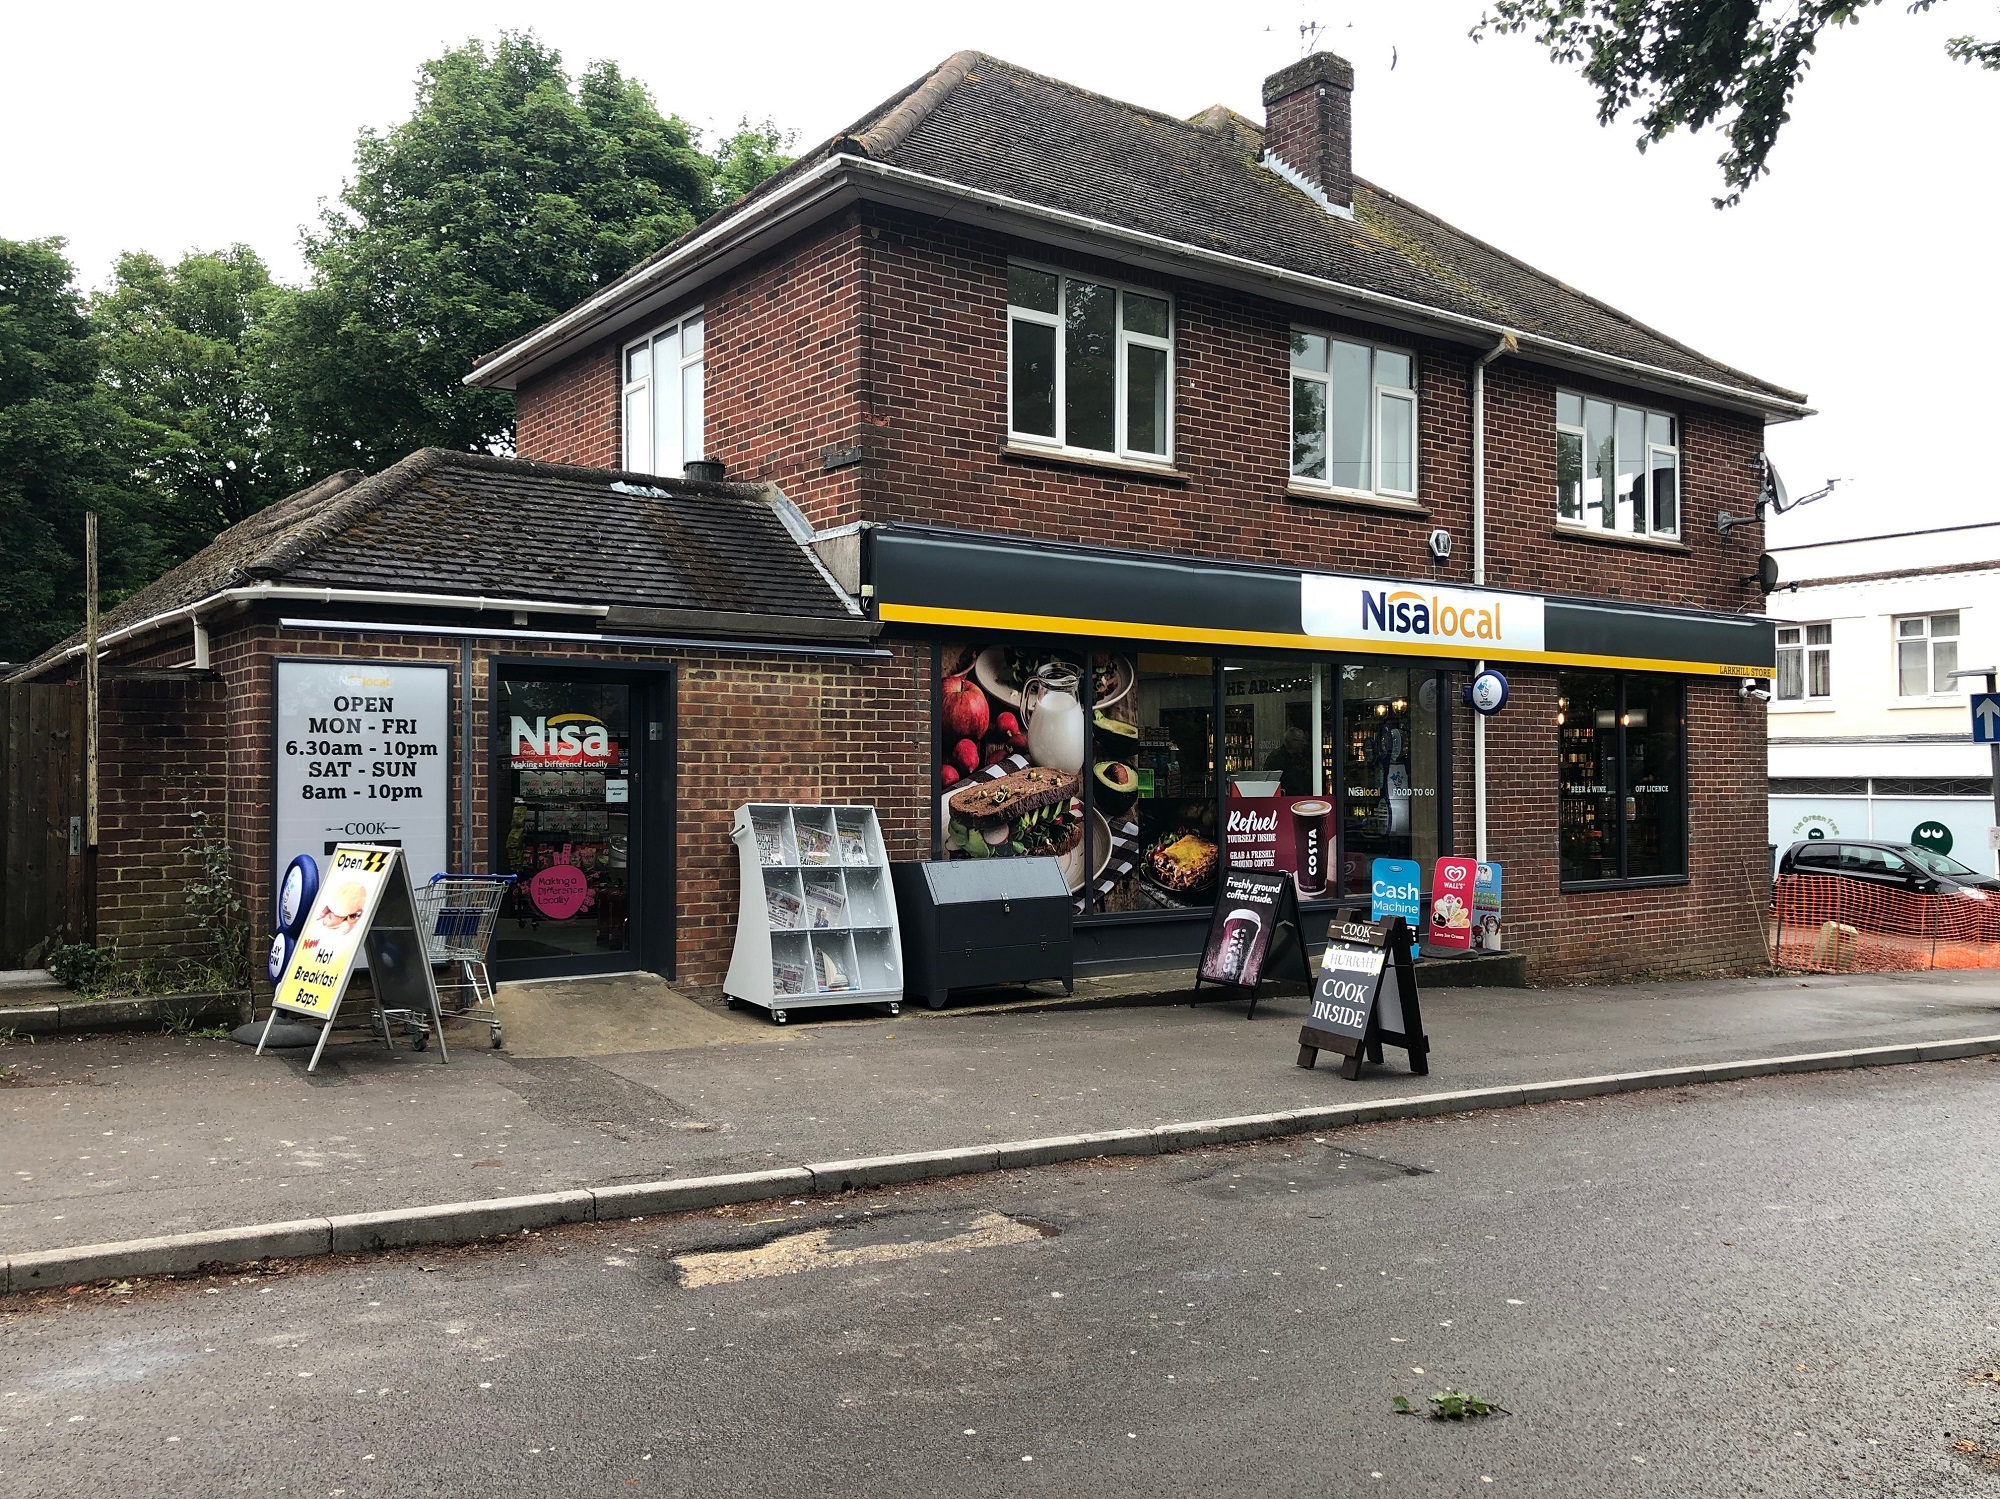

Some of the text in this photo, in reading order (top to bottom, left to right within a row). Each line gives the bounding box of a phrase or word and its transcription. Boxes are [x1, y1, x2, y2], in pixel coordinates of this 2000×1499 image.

[1361, 589, 1502, 641] Nisalocal
[1719, 665, 1771, 677] LARKHILL STORE
[1224, 680, 1245, 696] HE
[333, 696, 394, 713] OPEN
[308, 717, 362, 734] MON
[381, 718, 417, 735] FRI
[509, 713, 608, 756] Nisa
[285, 740, 363, 756] 6.30am
[383, 741, 438, 759] 10pm
[308, 761, 351, 778] SAT
[372, 761, 417, 778] SUN
[510, 760, 539, 769] Making
[544, 759, 582, 768] Difference
[583, 760, 609, 769] Locally
[301, 784, 347, 800] 8am
[368, 784, 423, 802] 10pm
[1348, 786, 1381, 797] Nisalocal
[1393, 788, 1435, 796] FOOD TO GO
[1571, 785, 1586, 793] BEER
[1592, 785, 1607, 793] WINE
[1635, 785, 1669, 793] OFF LICENCE
[345, 822, 386, 835] COOK
[1226, 810, 1278, 833] Refuel
[1792, 814, 1840, 836] The Green Tree
[1227, 833, 1276, 843] YOURSELF INSIDE
[1230, 851, 1246, 860] GRAB
[1251, 850, 1276, 859] FRESHLY
[1308, 828, 1318, 876] COSTA
[337, 853, 363, 871] Open
[1231, 859, 1275, 868] GROUND COFFEE
[538, 877, 570, 888] Making
[1226, 876, 1282, 894] Freshly ground
[1372, 880, 1419, 900] Cash
[1443, 881, 1464, 890] WALL'S
[538, 887, 584, 896] Difference
[1226, 889, 1273, 904] coffee inside.
[538, 896, 570, 906] Locally
[1373, 900, 1419, 914] Machine
[1342, 923, 1372, 938] COOK
[302, 938, 320, 950] New
[1223, 928, 1241, 973] COSTA
[314, 947, 334, 965] Hot
[1330, 953, 1377, 969] HURRAH!
[294, 965, 338, 988] Breakfast
[295, 987, 319, 1007] Baps
[1322, 978, 1369, 1004] COOK
[1312, 1000, 1366, 1029] INSIDE
